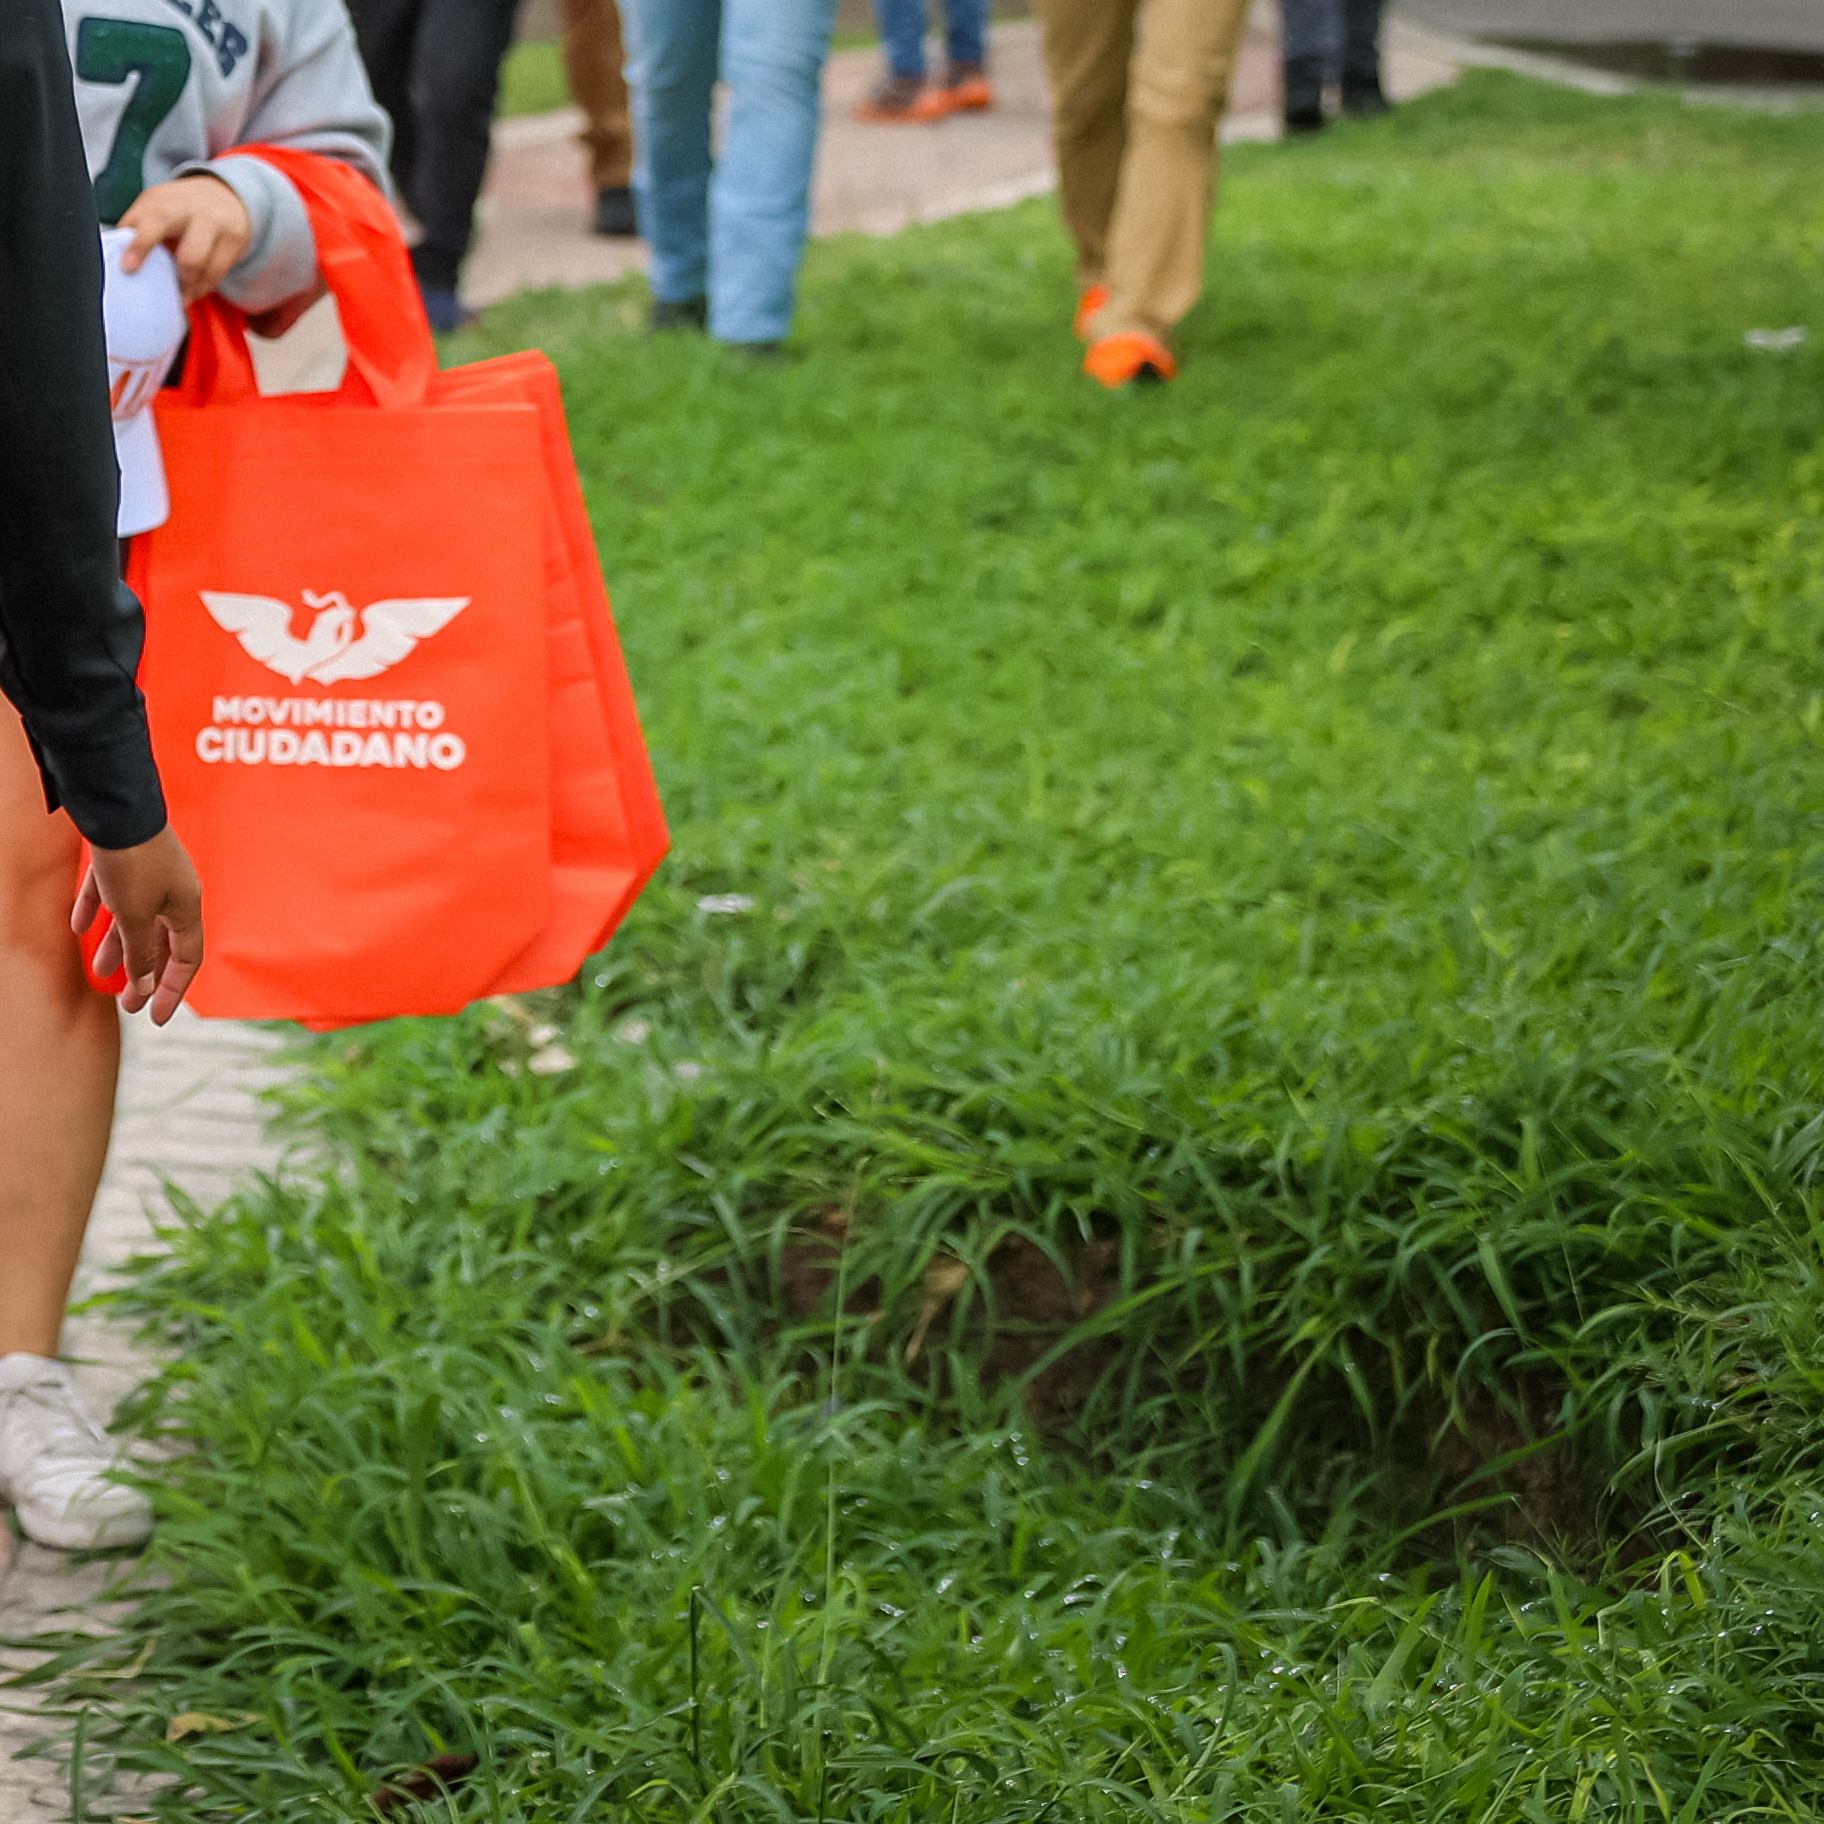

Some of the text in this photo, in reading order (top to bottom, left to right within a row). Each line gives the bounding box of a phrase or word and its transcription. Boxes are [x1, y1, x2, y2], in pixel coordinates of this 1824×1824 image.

[76, 15, 192, 225] 7
[212, 695, 446, 731] MOVIMIENTO
[194, 726, 467, 771] CIUDADANO
